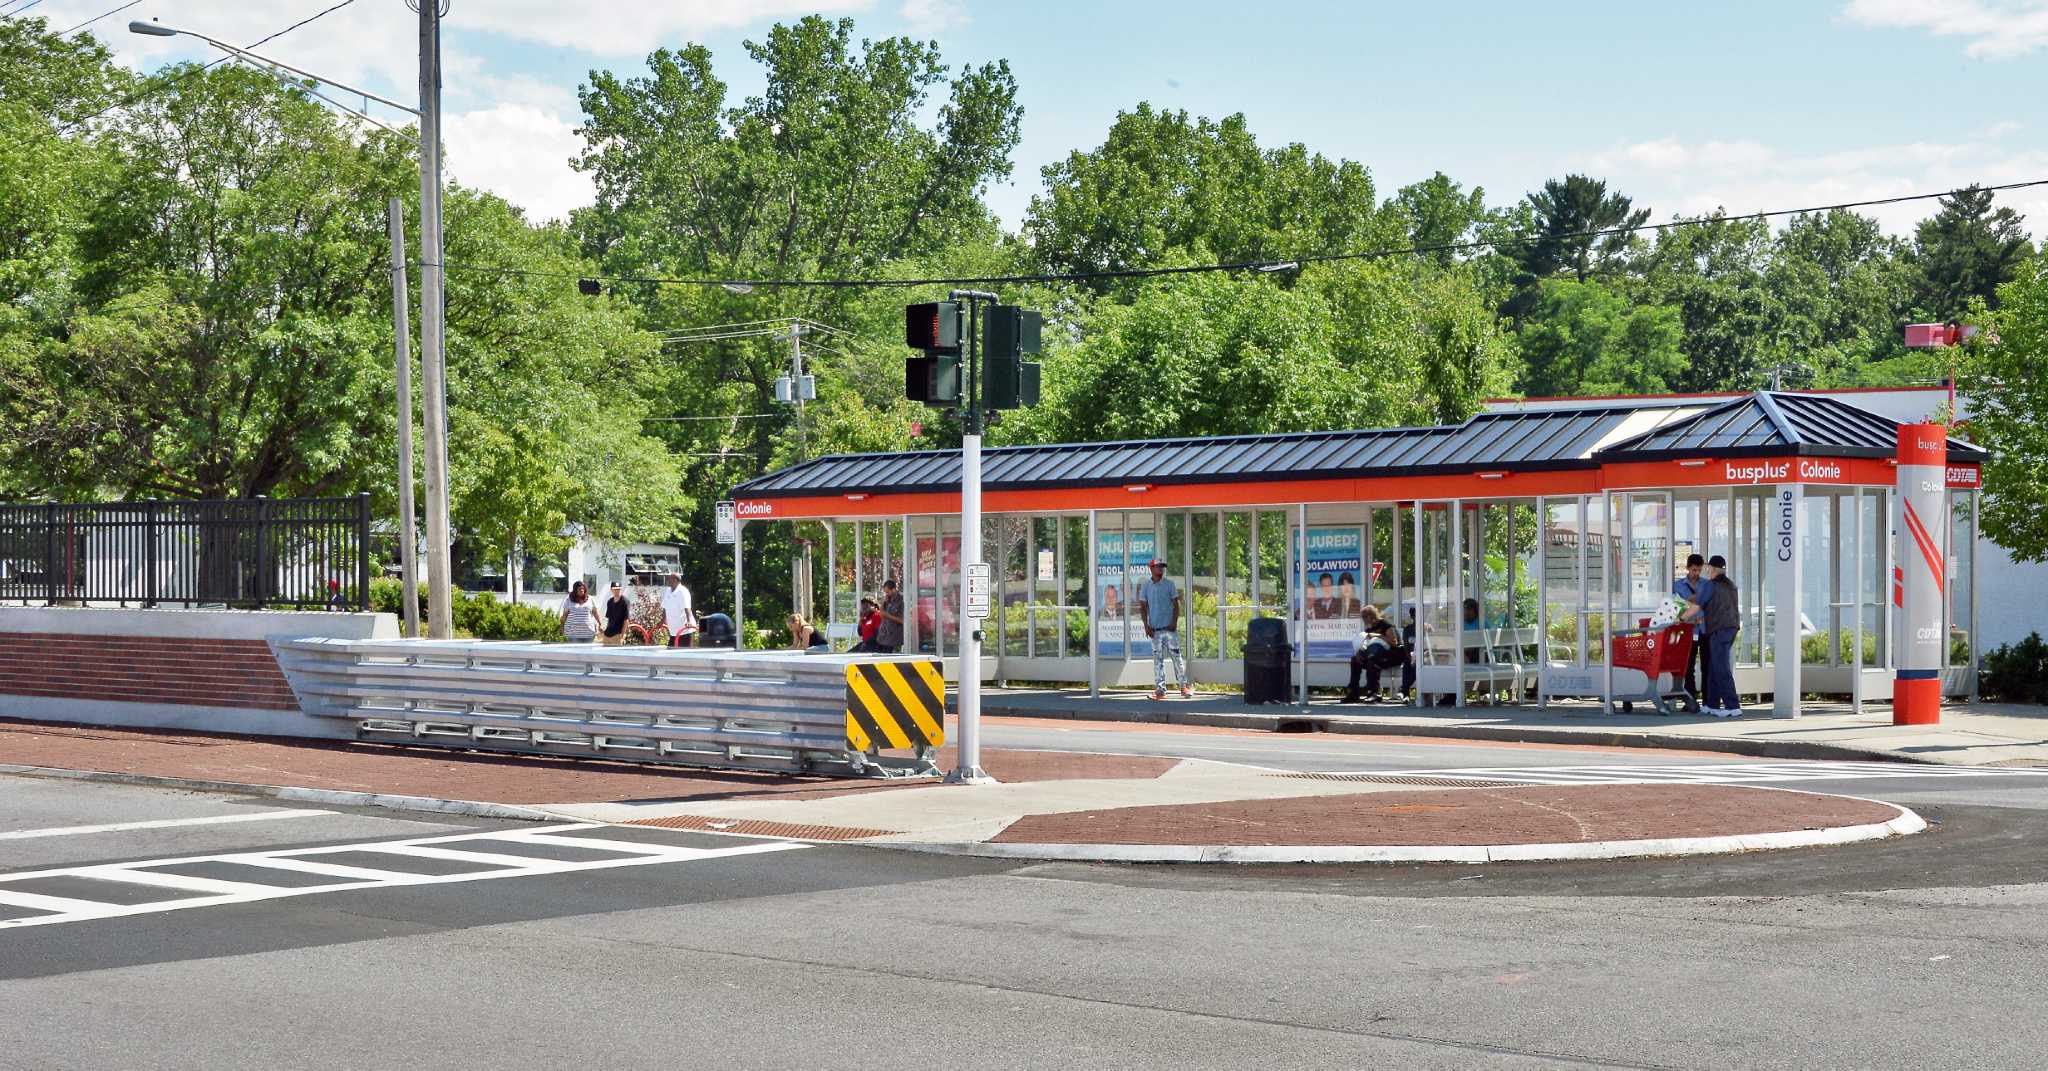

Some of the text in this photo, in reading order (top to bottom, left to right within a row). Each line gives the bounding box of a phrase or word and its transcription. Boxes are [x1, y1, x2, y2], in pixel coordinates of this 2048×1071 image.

[1726, 461, 1787, 484] busplus
[1800, 460, 1840, 478] Colonie
[737, 501, 772, 515] Colonie
[1778, 490, 1793, 562] Colonie
[1296, 534, 1359, 549] IJURED?
[1296, 558, 1359, 572] 100LAW1010
